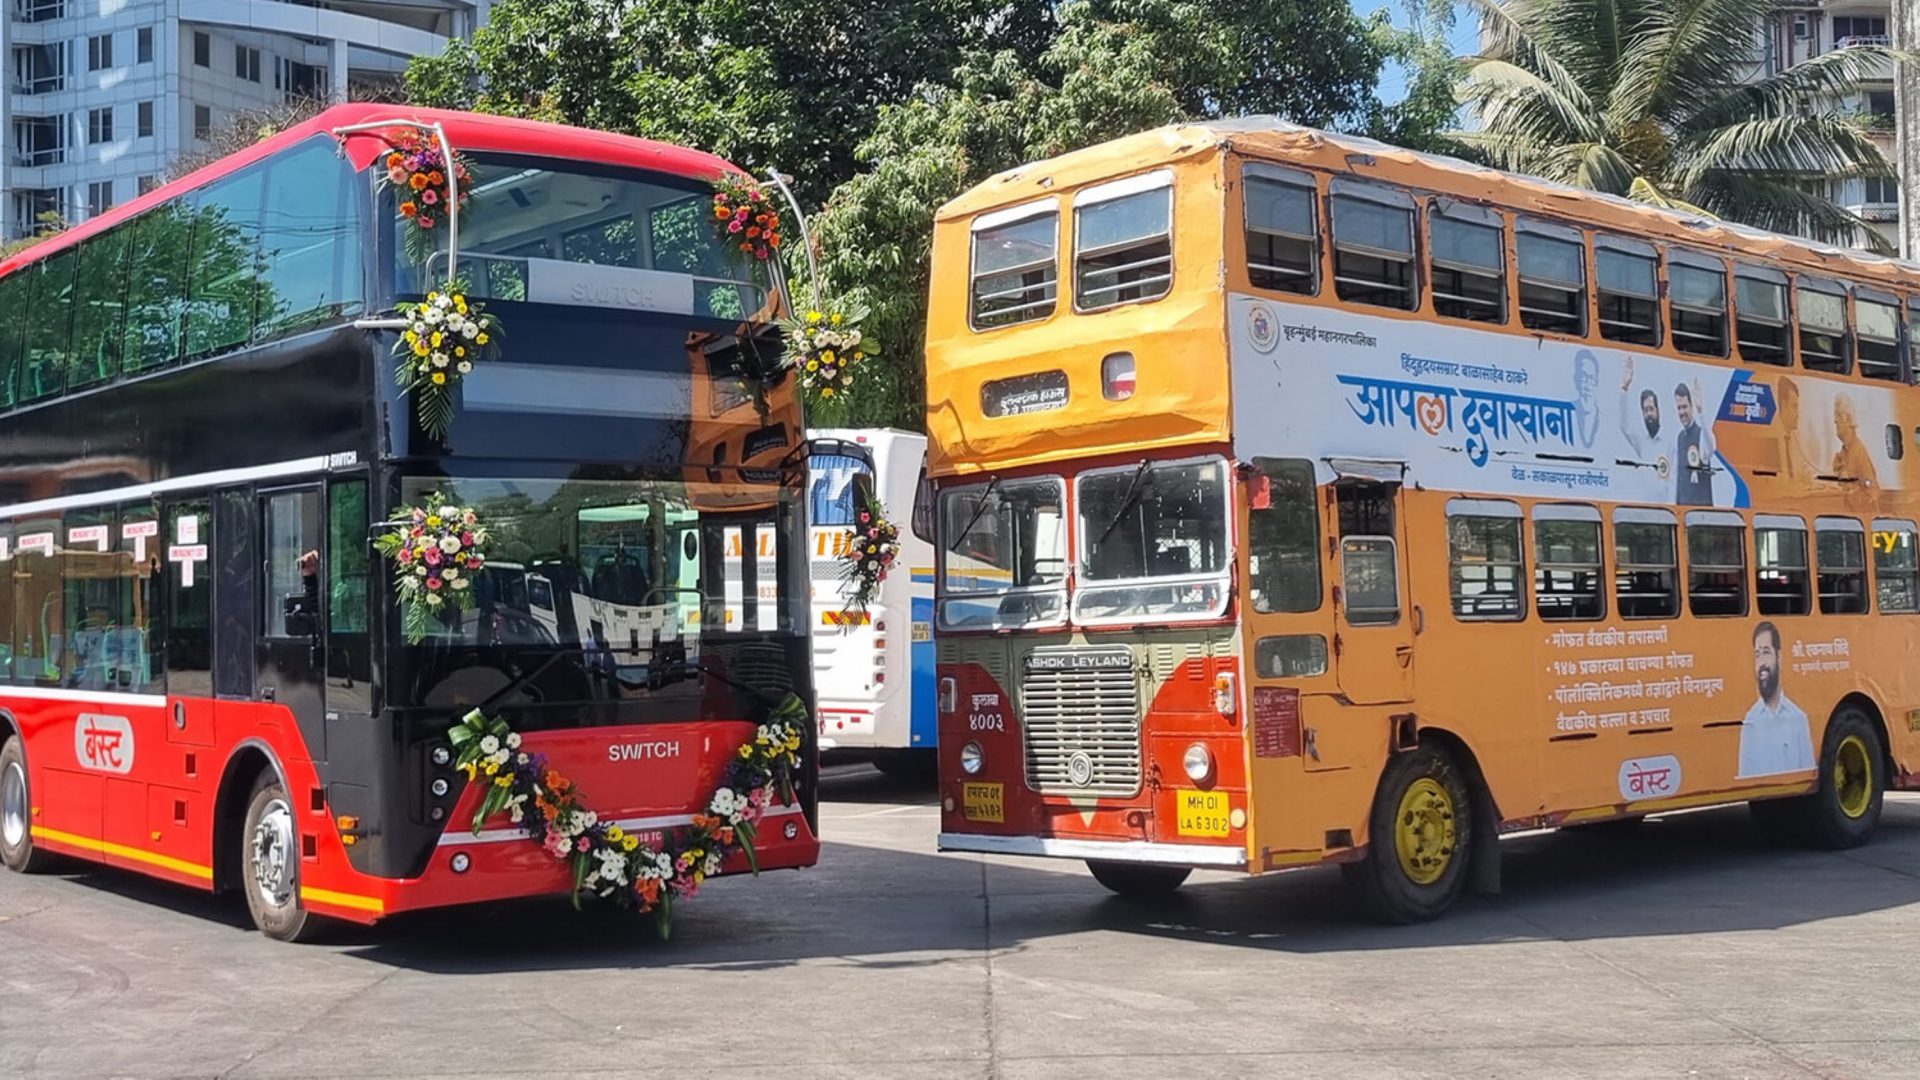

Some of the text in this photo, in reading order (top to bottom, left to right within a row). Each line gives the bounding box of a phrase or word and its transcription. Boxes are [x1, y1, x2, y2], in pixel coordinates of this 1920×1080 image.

[571, 281, 656, 308] SWITCH
[1318, 328, 1377, 347] महानगरपालिका
[1461, 363, 1504, 383] बाळासाहेब
[1505, 368, 1528, 385] ठाकरे
[1336, 374, 1576, 468] आपला दवाखाना
[330, 450, 357, 467] SWITCH
[1552, 628, 1584, 648] मोफत
[1627, 625, 1667, 645] तपासणी
[1026, 655, 1131, 668] ASHOK LEYLAND
[1666, 650, 1694, 669] मोफत
[1683, 675, 1724, 698] विनामूल्य
[1599, 712, 1628, 729] सल्ला
[1638, 708, 1670, 725] उपचार
[84, 717, 122, 767] बेस्ट
[608, 741, 681, 762] SWITCH
[1627, 761, 1672, 795] बेस्ट
[1188, 796, 1204, 809] MH
[1180, 816, 1228, 832] LA 6302
